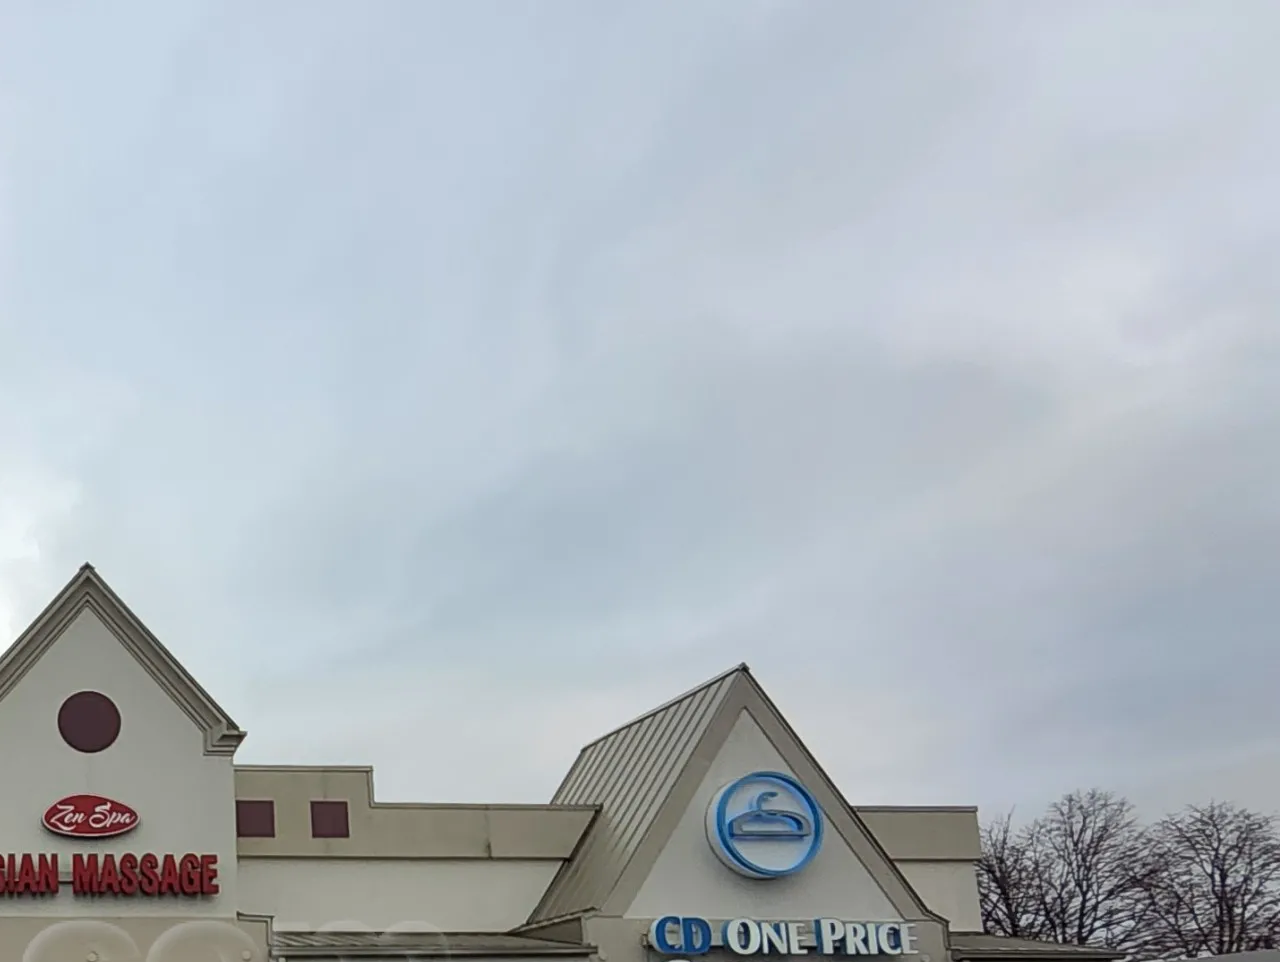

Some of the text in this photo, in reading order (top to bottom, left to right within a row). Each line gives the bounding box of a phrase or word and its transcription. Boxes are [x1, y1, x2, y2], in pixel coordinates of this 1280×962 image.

[50, 802, 135, 830] Zen Spa
[72, 853, 219, 895] MASSAGE
[650, 916, 712, 955] CD
